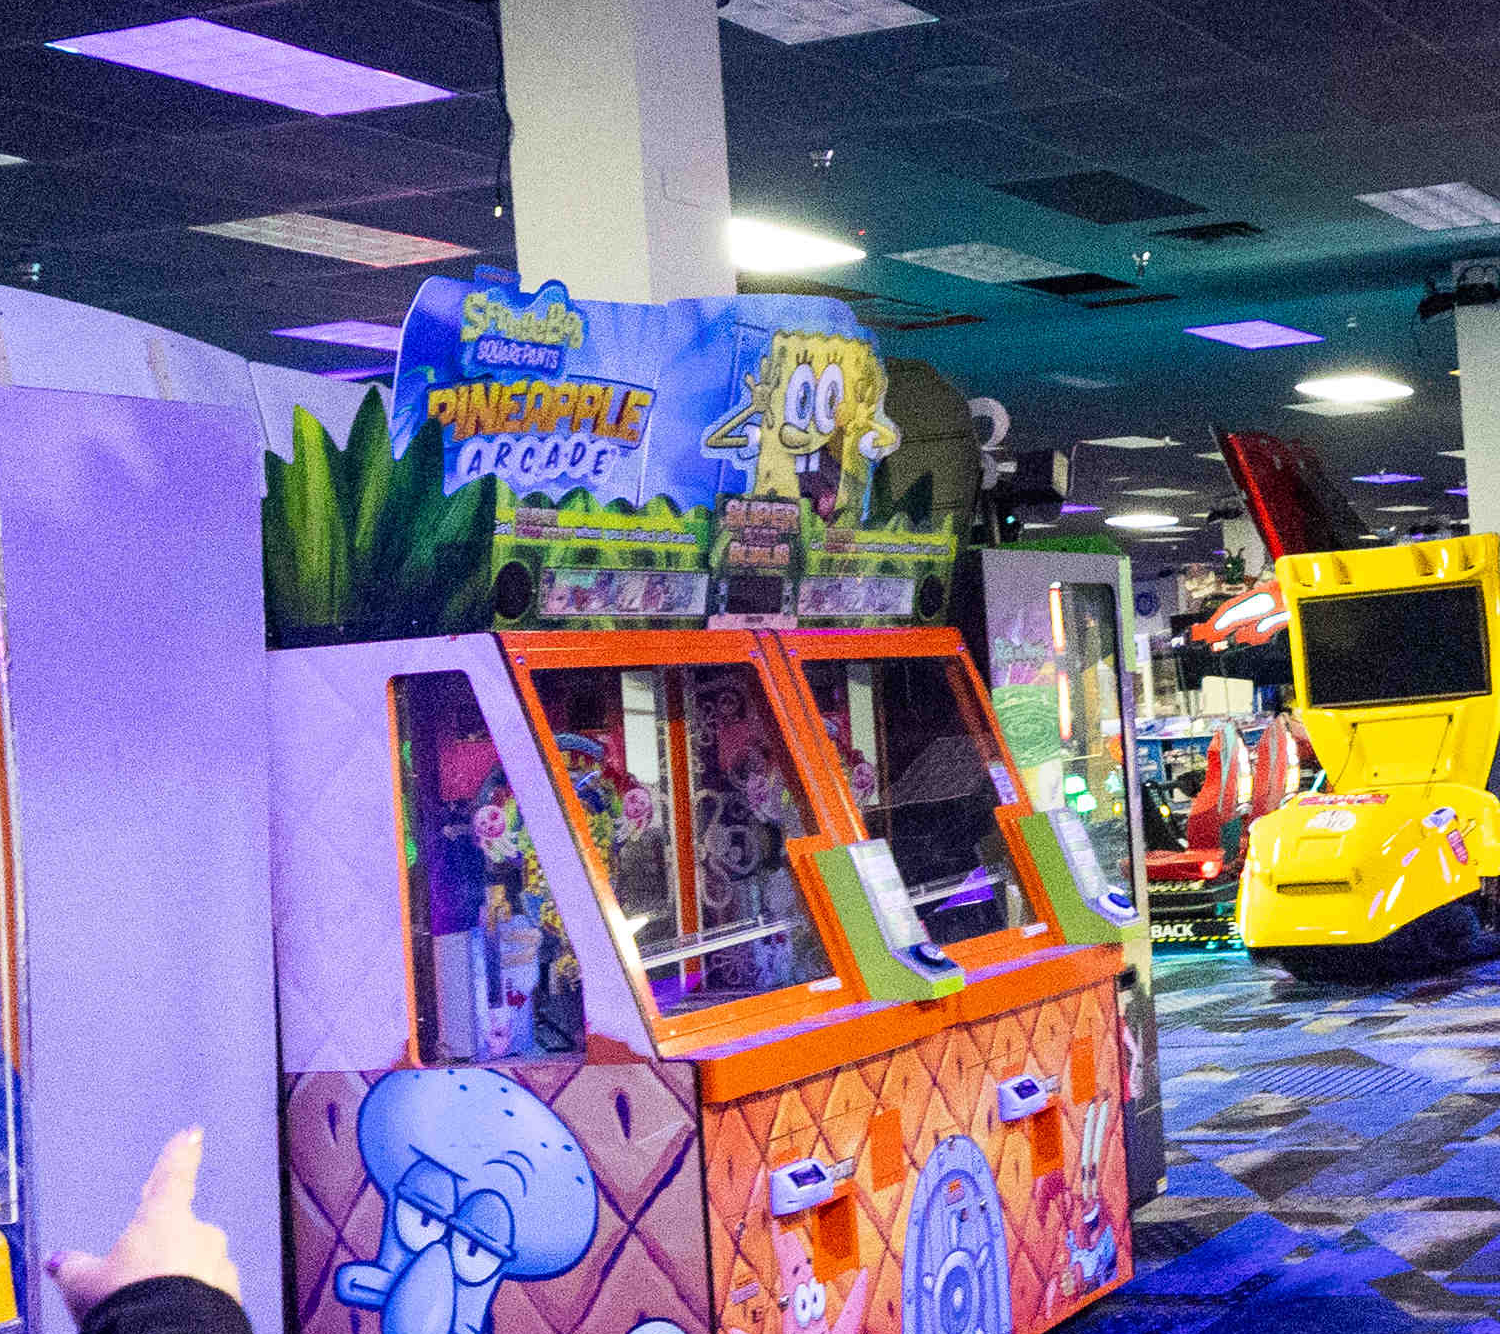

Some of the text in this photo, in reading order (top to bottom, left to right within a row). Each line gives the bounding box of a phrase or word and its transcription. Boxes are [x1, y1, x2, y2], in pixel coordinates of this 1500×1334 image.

[428, 380, 652, 442] PINEAPPLE
[466, 443, 608, 475] ARCADE
[1150, 923, 1195, 939] BACK
